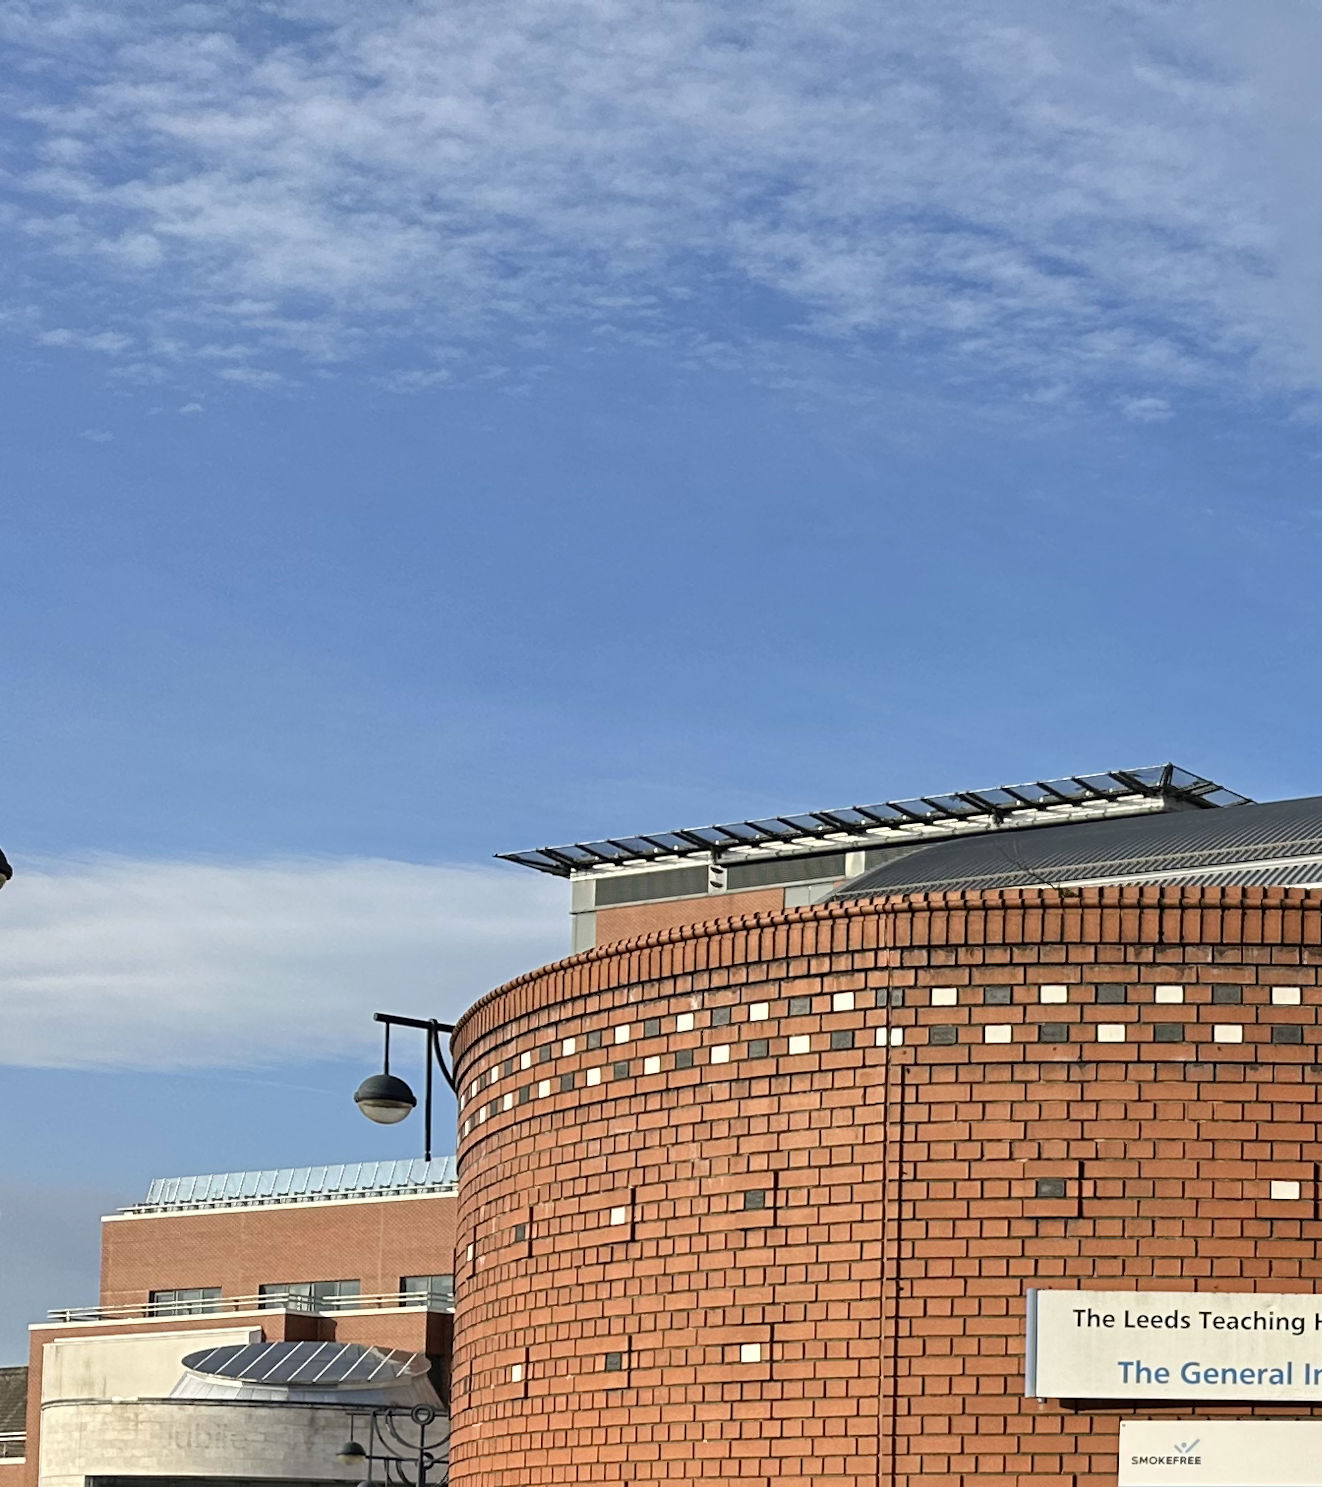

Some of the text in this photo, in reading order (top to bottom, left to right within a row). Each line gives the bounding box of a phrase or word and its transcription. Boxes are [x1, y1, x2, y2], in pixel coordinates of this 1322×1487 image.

[1073, 1308, 1115, 1328] The
[1124, 1310, 1191, 1329] Leeds
[1199, 1311, 1306, 1336] Teaching
[1118, 1360, 1170, 1384] The
[1180, 1361, 1293, 1386] General
[1131, 1456, 1201, 1465] SMOKEFREE
